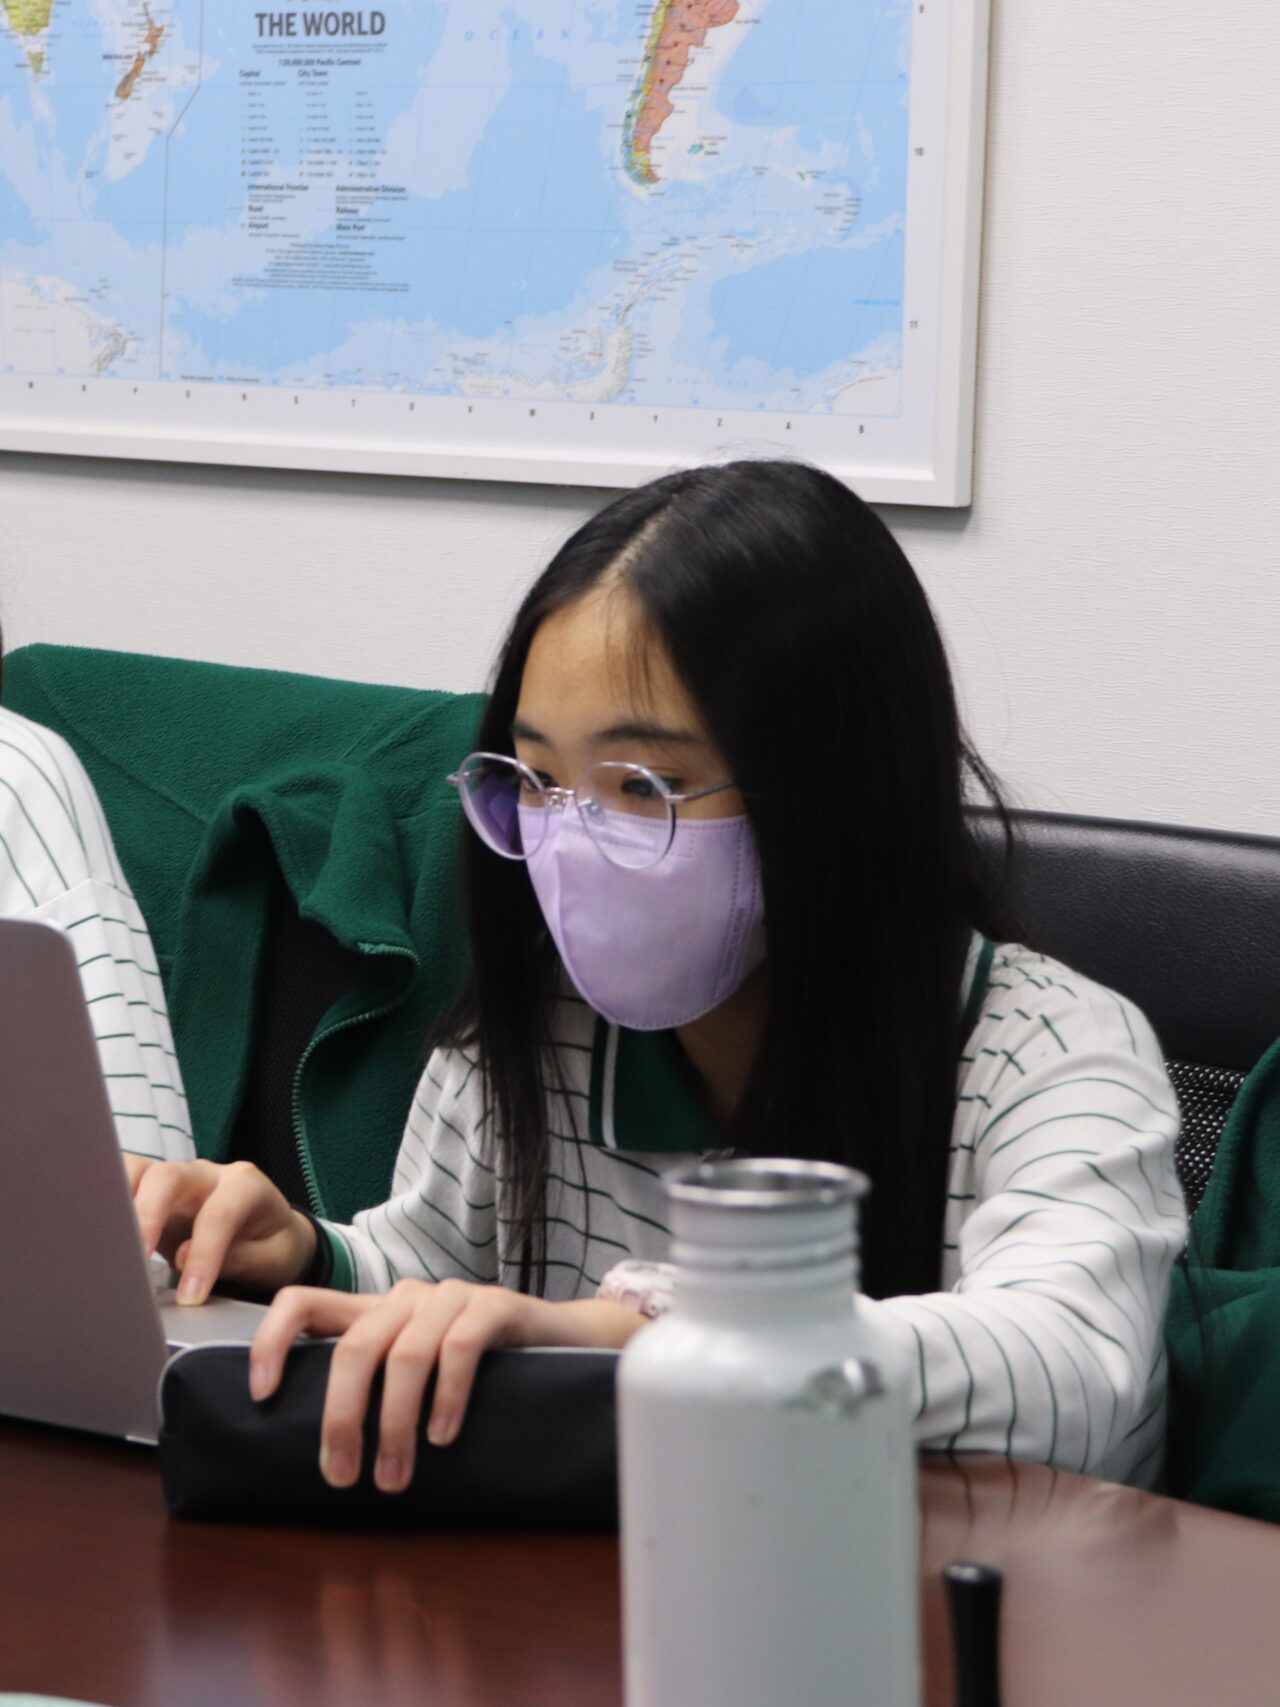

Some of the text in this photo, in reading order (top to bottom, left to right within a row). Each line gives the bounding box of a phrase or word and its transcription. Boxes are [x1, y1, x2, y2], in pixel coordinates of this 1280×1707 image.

[254, 11, 386, 37] THE WORLD
[465, 29, 569, 41] OCEAN
